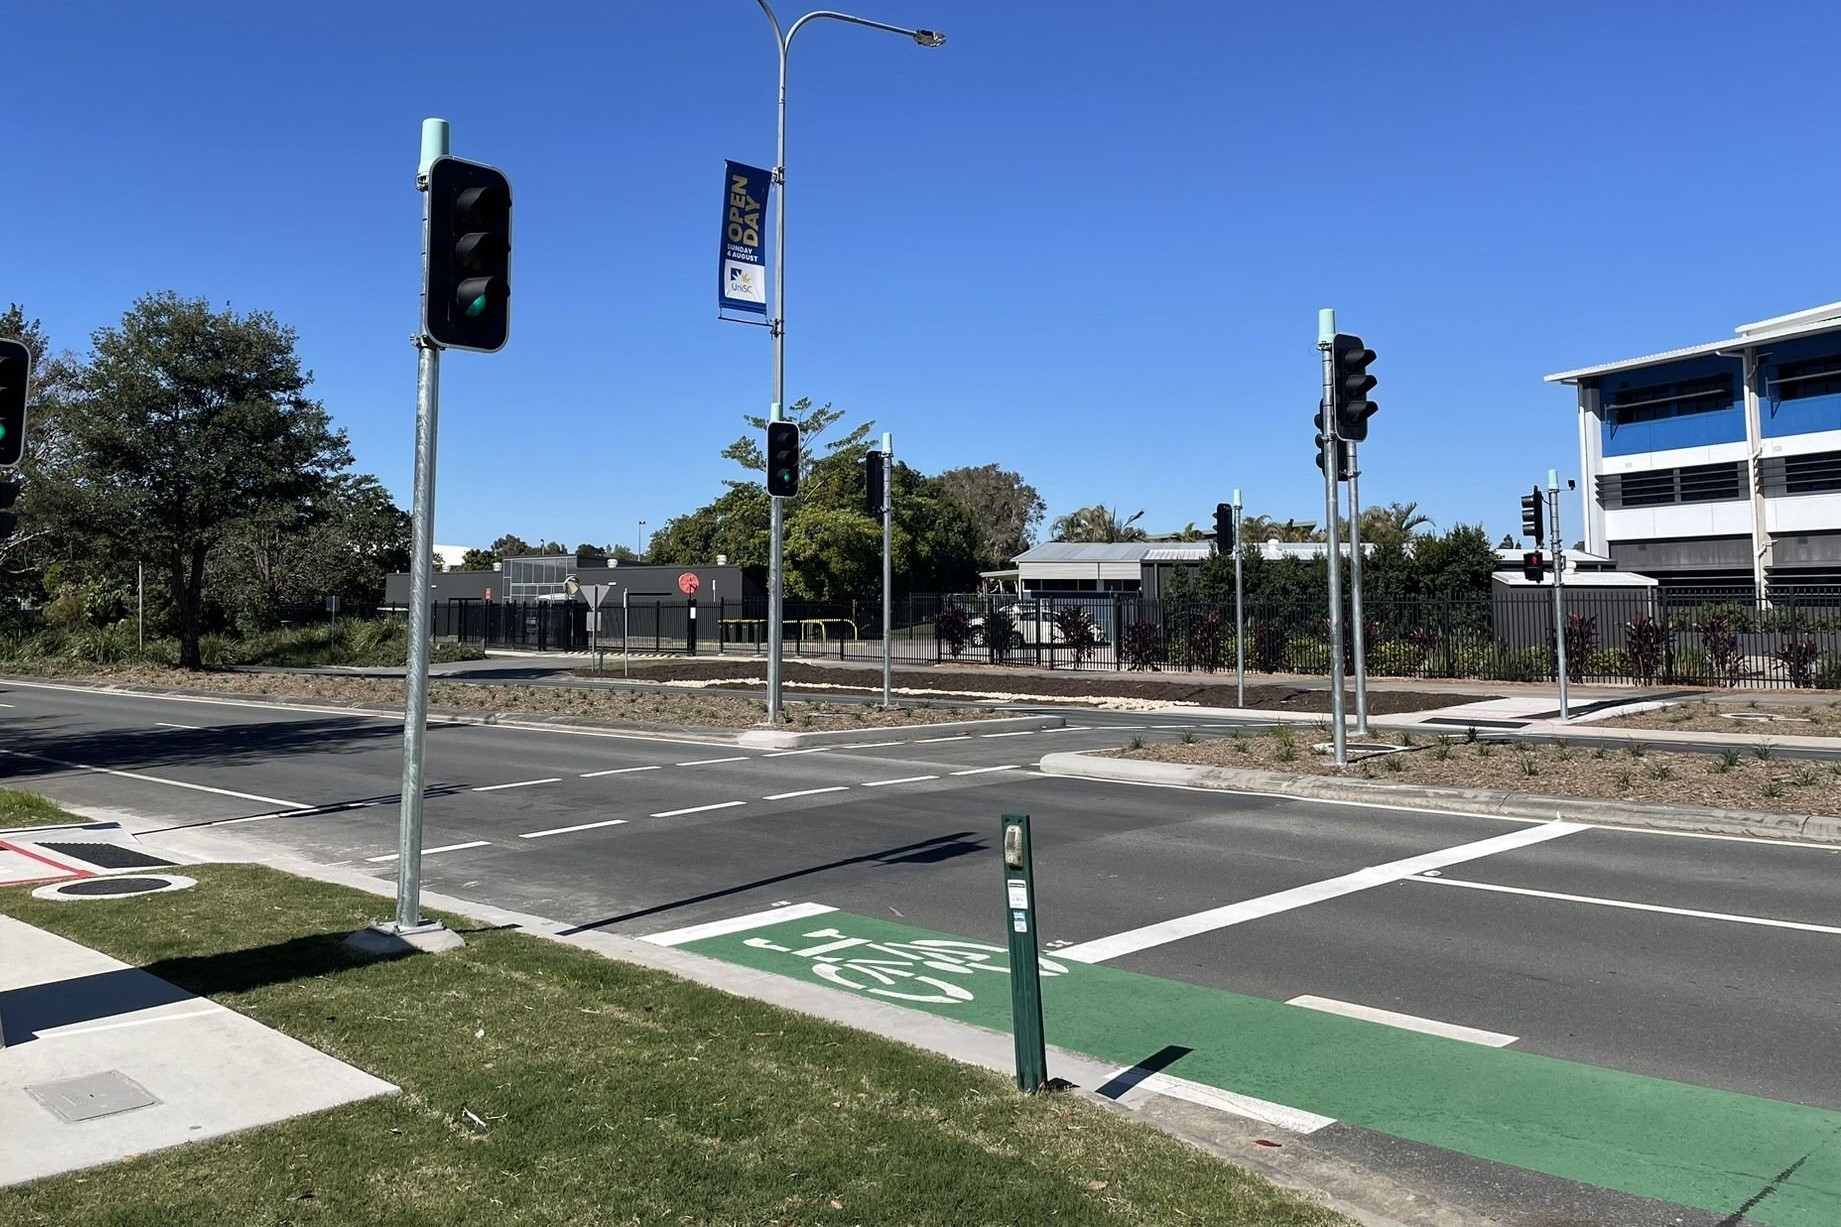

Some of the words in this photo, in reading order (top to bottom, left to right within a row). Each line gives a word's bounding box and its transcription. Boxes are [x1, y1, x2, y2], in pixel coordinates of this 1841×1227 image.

[728, 175, 748, 242] OPEN
[742, 194, 761, 247] DAY
[727, 243, 753, 254] SUNDAY
[732, 252, 758, 263] AUGUST
[731, 282, 753, 294] UniSC
